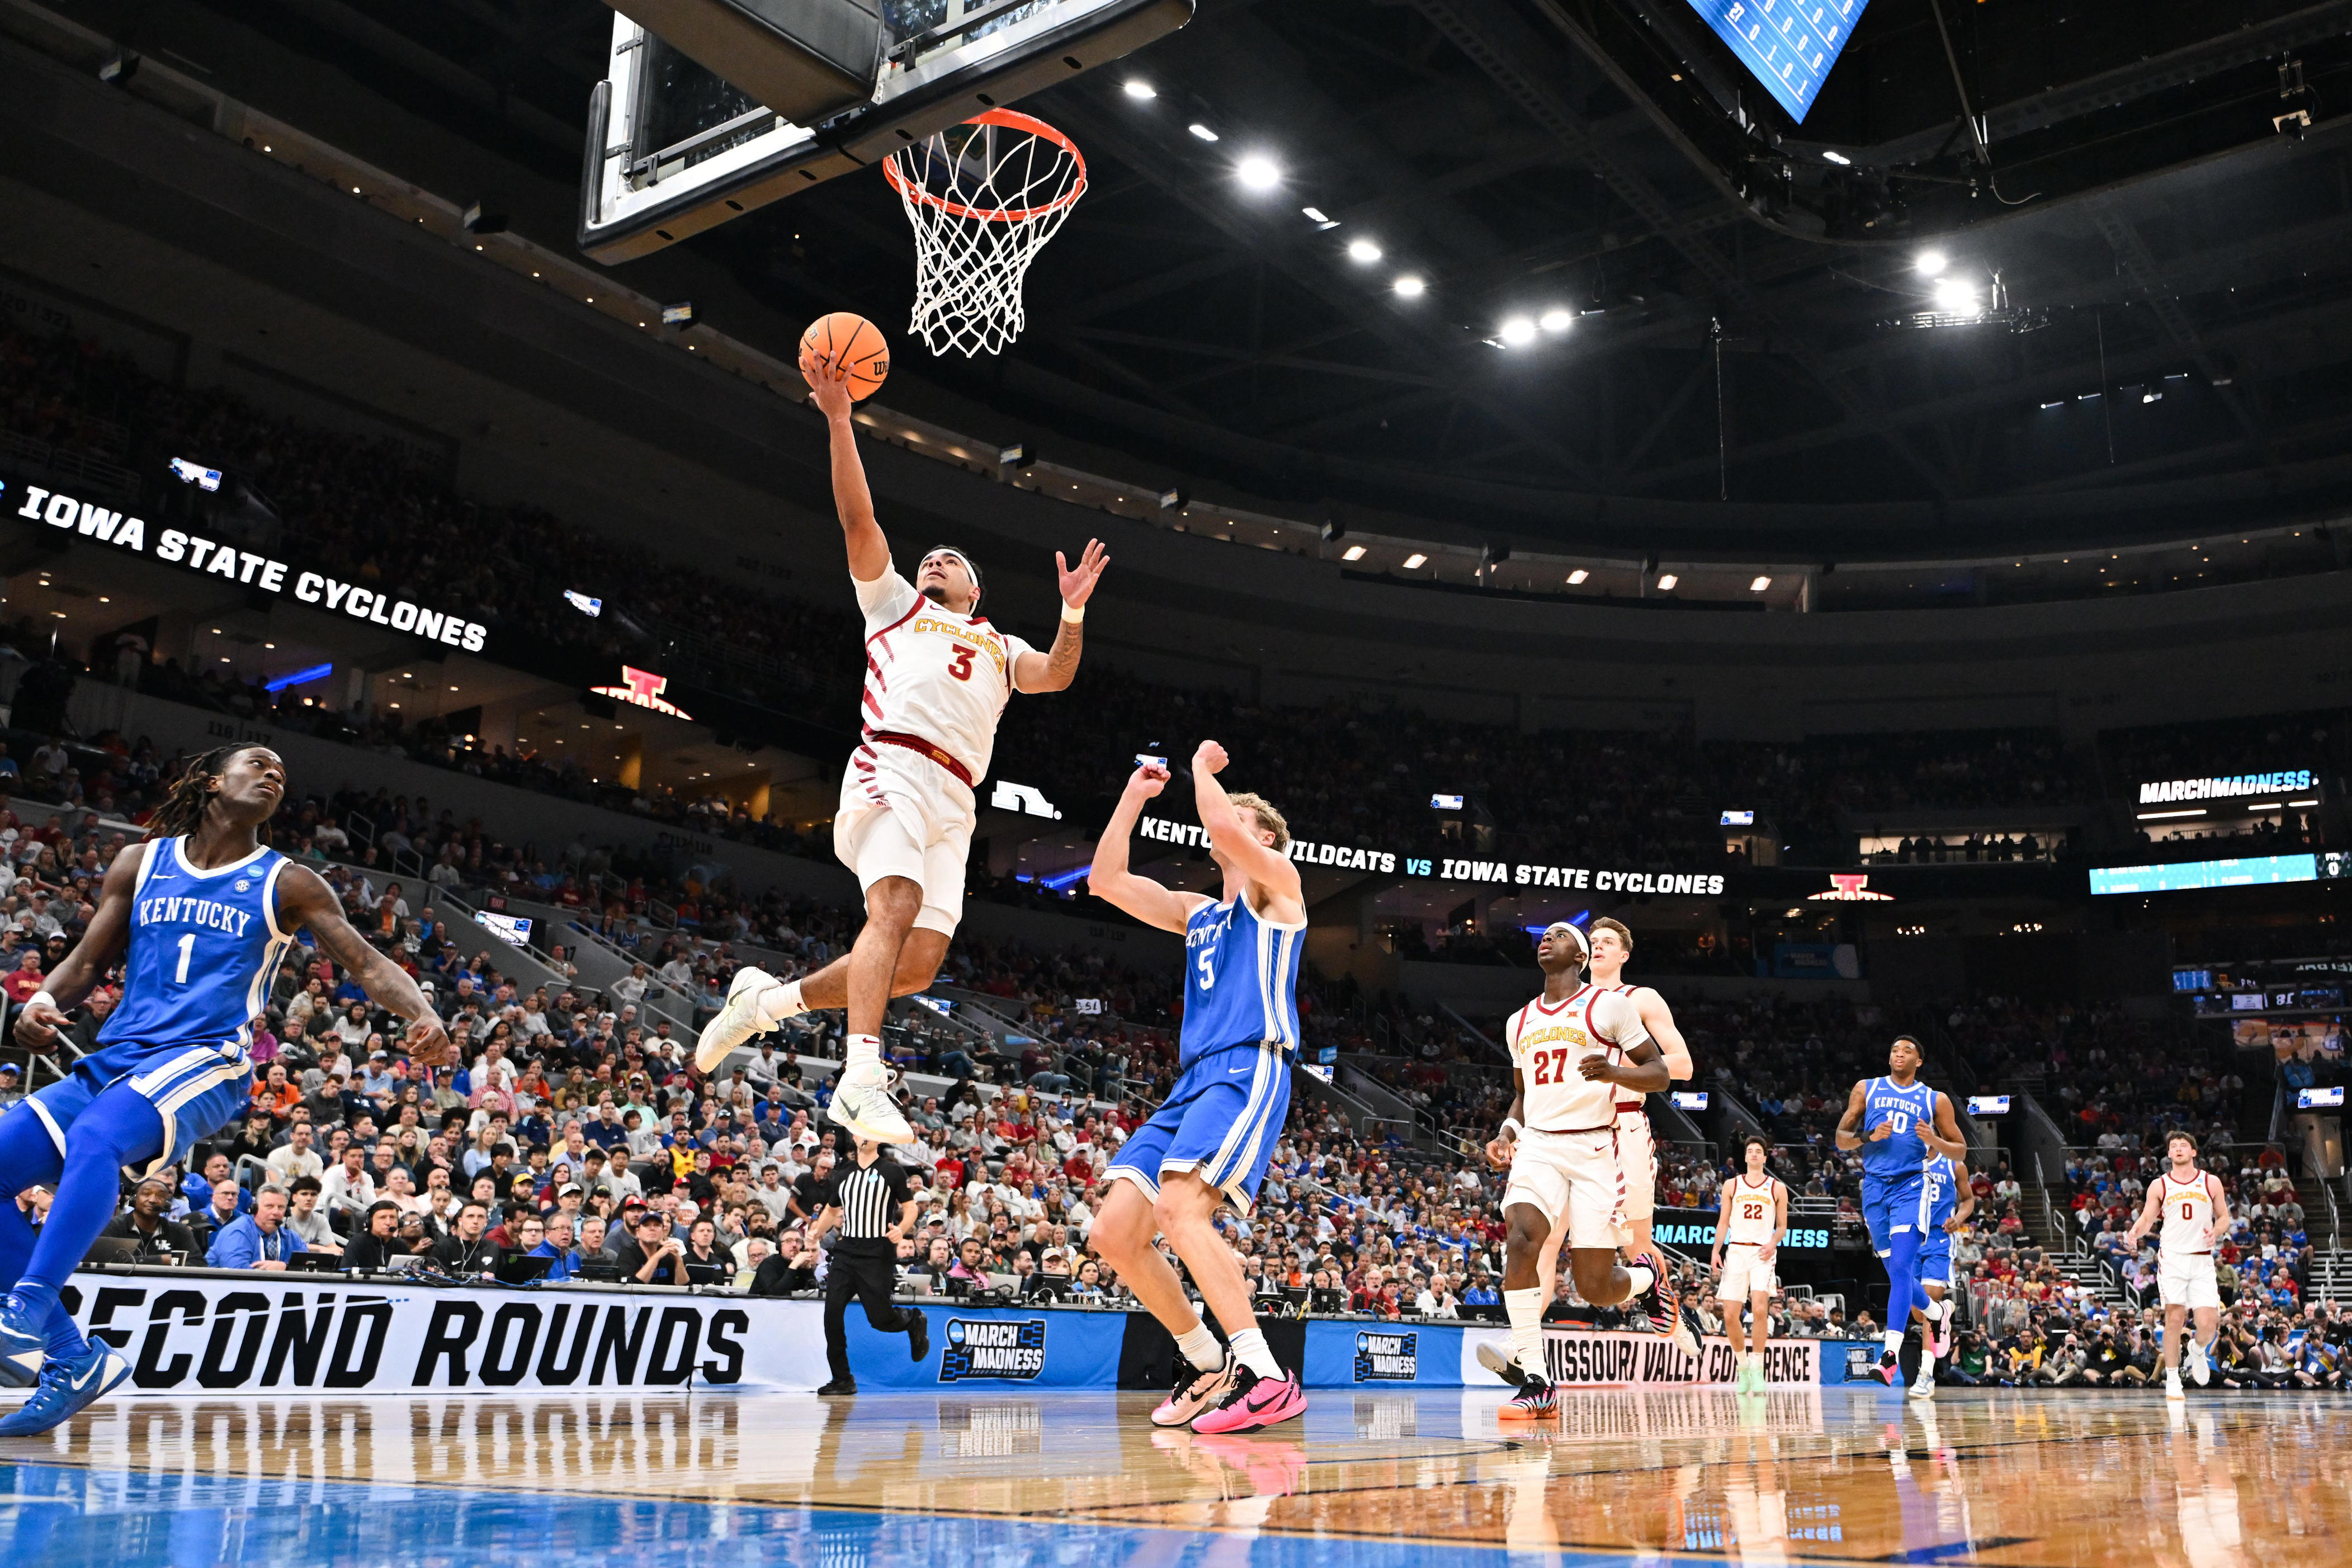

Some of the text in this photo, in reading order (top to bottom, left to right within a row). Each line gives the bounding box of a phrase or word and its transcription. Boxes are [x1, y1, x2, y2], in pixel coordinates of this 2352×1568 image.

[1813, 7, 1838, 42] 0 0
[1749, 24, 1760, 41] 0
[1783, 63, 1793, 78] 0
[1782, 17, 1793, 34] 0
[1798, 35, 1808, 51] 0
[1813, 53, 1823, 69] 0
[19, 485, 487, 652] IOWA STATE CYCLONES
[914, 618, 1005, 674] CYCLONES
[948, 643, 977, 682] 3
[2140, 770, 2310, 804] MARCHMADNESS
[1140, 816, 1213, 850] KENTU
[1406, 858, 1432, 876] VS
[1440, 858, 1508, 883] IOWA
[1514, 865, 1590, 889] STATE
[1595, 871, 1725, 895] CYCLONES
[2329, 862, 2339, 875] 0
[140, 897, 251, 937] KENTUCKY
[175, 933, 196, 984] 1
[1198, 945, 1215, 991] 5
[1519, 1027, 1586, 1055] CYCLONES
[1534, 1048, 1567, 1086] 27
[1874, 1097, 1922, 1117] KENTUCKY
[1886, 1110, 1908, 1134] 10
[1736, 1193, 1770, 1205] CYCLONES
[1744, 1204, 1762, 1220] 22
[2166, 1191, 2208, 1206] CYCLONES
[2182, 1203, 2192, 1220] 0
[412, 1300, 749, 1387] ROUNDS
[965, 1324, 1018, 1347] MARCH
[1368, 1335, 1402, 1356] MARCH
[972, 1347, 1043, 1371] MADNESS
[1373, 1354, 1415, 1374] MADNESS
[1542, 1338, 1810, 1382] MISSOURI VALLEY CORENCE
